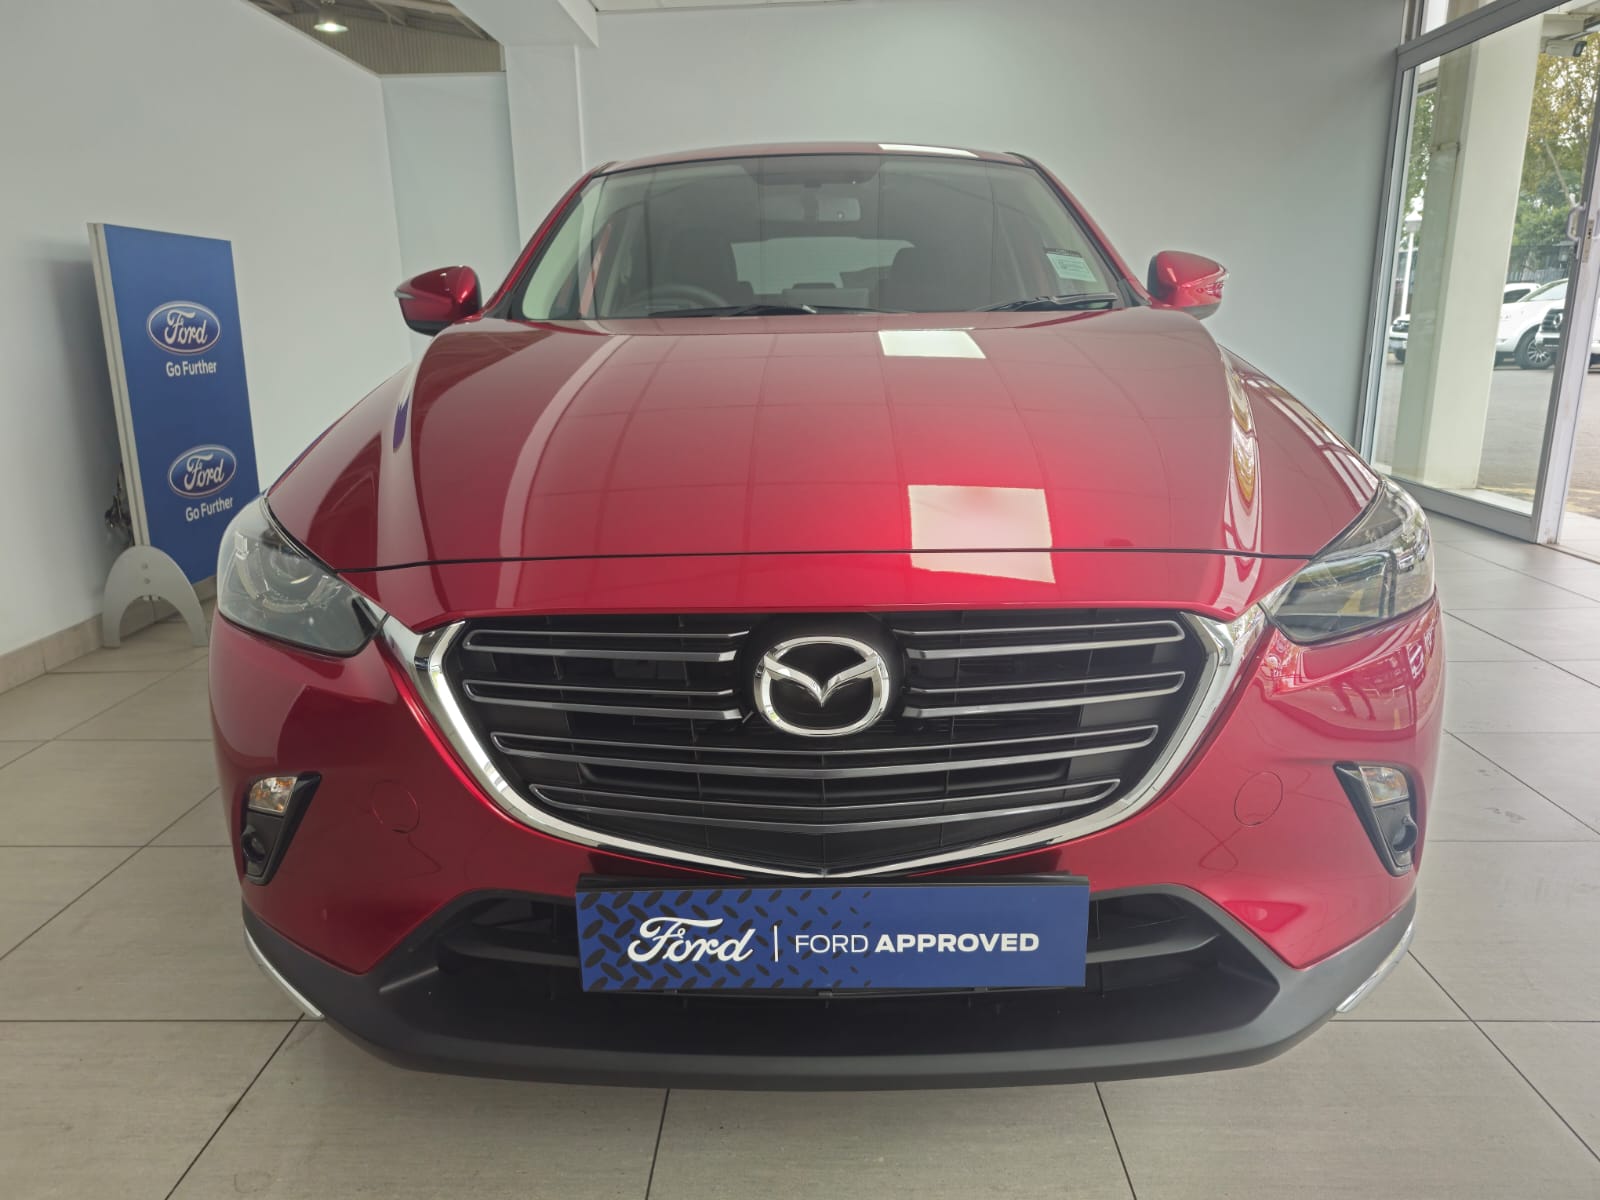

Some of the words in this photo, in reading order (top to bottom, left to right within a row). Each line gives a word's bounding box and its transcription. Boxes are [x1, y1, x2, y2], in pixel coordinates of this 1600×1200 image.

[164, 309, 208, 345] Ford
[166, 361, 181, 377] Go
[182, 360, 217, 375] Further
[184, 454, 224, 490] Ford
[185, 507, 199, 521] Go
[200, 496, 233, 517] Further
[627, 916, 756, 962] Ford
[795, 934, 868, 953] FORD
[875, 933, 1039, 953] APPROVED
